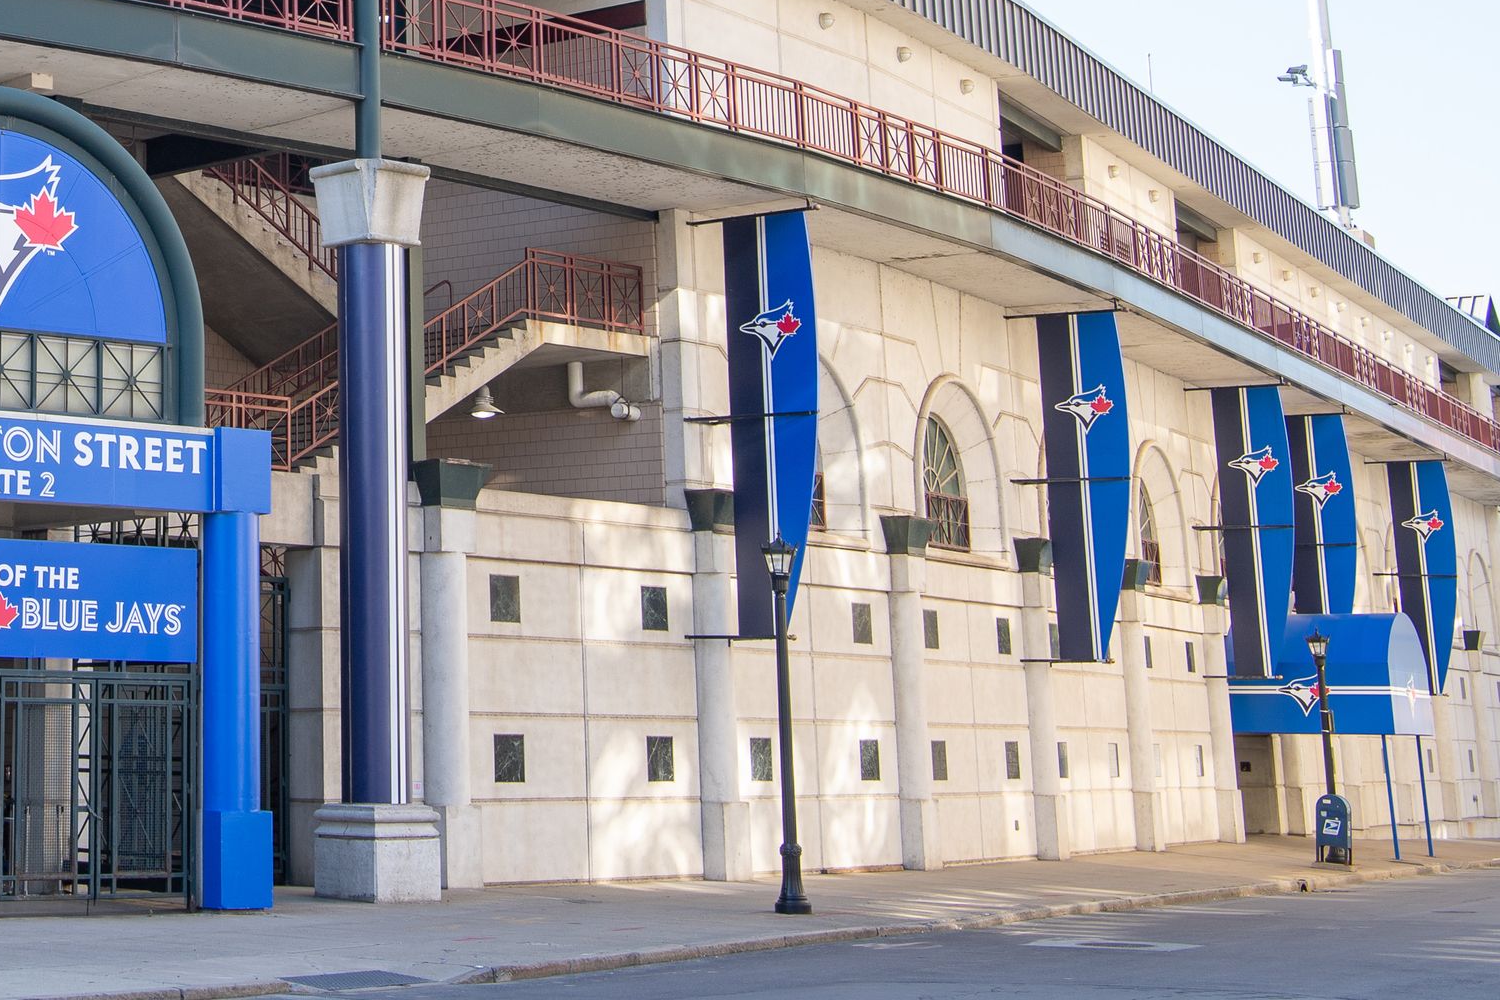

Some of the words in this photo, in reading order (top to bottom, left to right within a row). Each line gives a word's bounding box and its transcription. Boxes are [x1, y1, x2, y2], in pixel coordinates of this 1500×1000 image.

[73, 431, 207, 474] STREET
[39, 471, 56, 498] 2
[33, 565, 80, 590] THE
[21, 597, 99, 632] BLUE
[105, 601, 181, 636] JAYS
